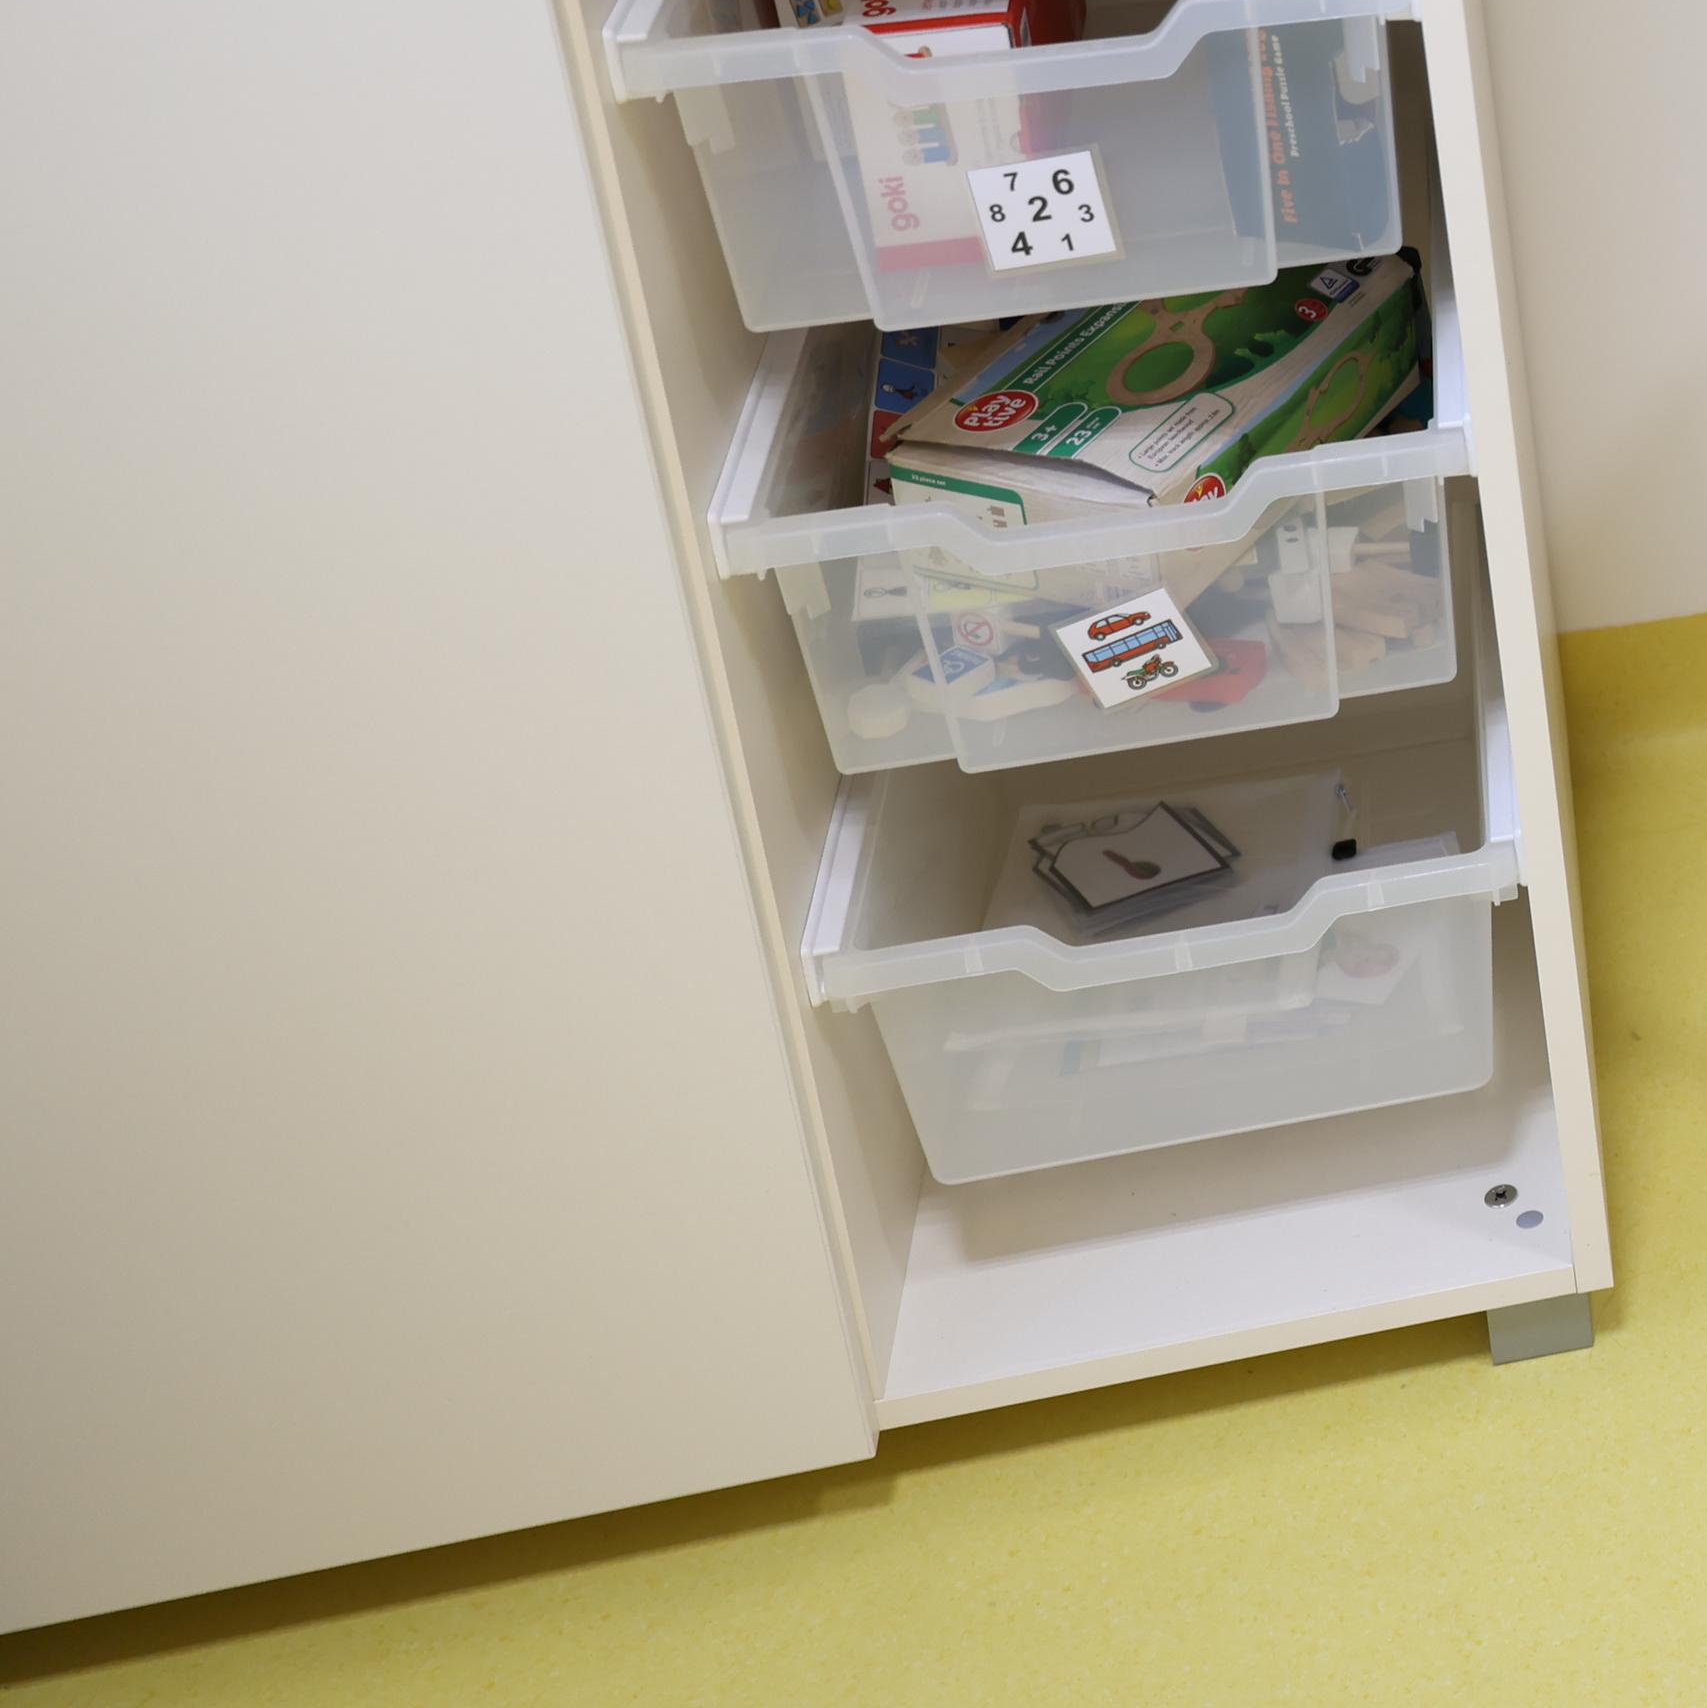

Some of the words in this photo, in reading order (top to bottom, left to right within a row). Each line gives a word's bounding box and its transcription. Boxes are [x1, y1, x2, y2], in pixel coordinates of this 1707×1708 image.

[1283, 101, 1300, 157] Preschool
[1003, 172, 1018, 191] 7
[1052, 169, 1074, 195] 6
[878, 176, 920, 231] goki
[989, 204, 1006, 222] 8
[1027, 196, 1052, 222] 2
[1078, 204, 1094, 222] 3
[1011, 231, 1033, 256] 4
[1061, 233, 1075, 251] 1
[1023, 365, 1052, 384] Rail
[1045, 338, 1085, 366] Points
[1031, 425, 1057, 441] 3+
[1066, 430, 1092, 446] 23
